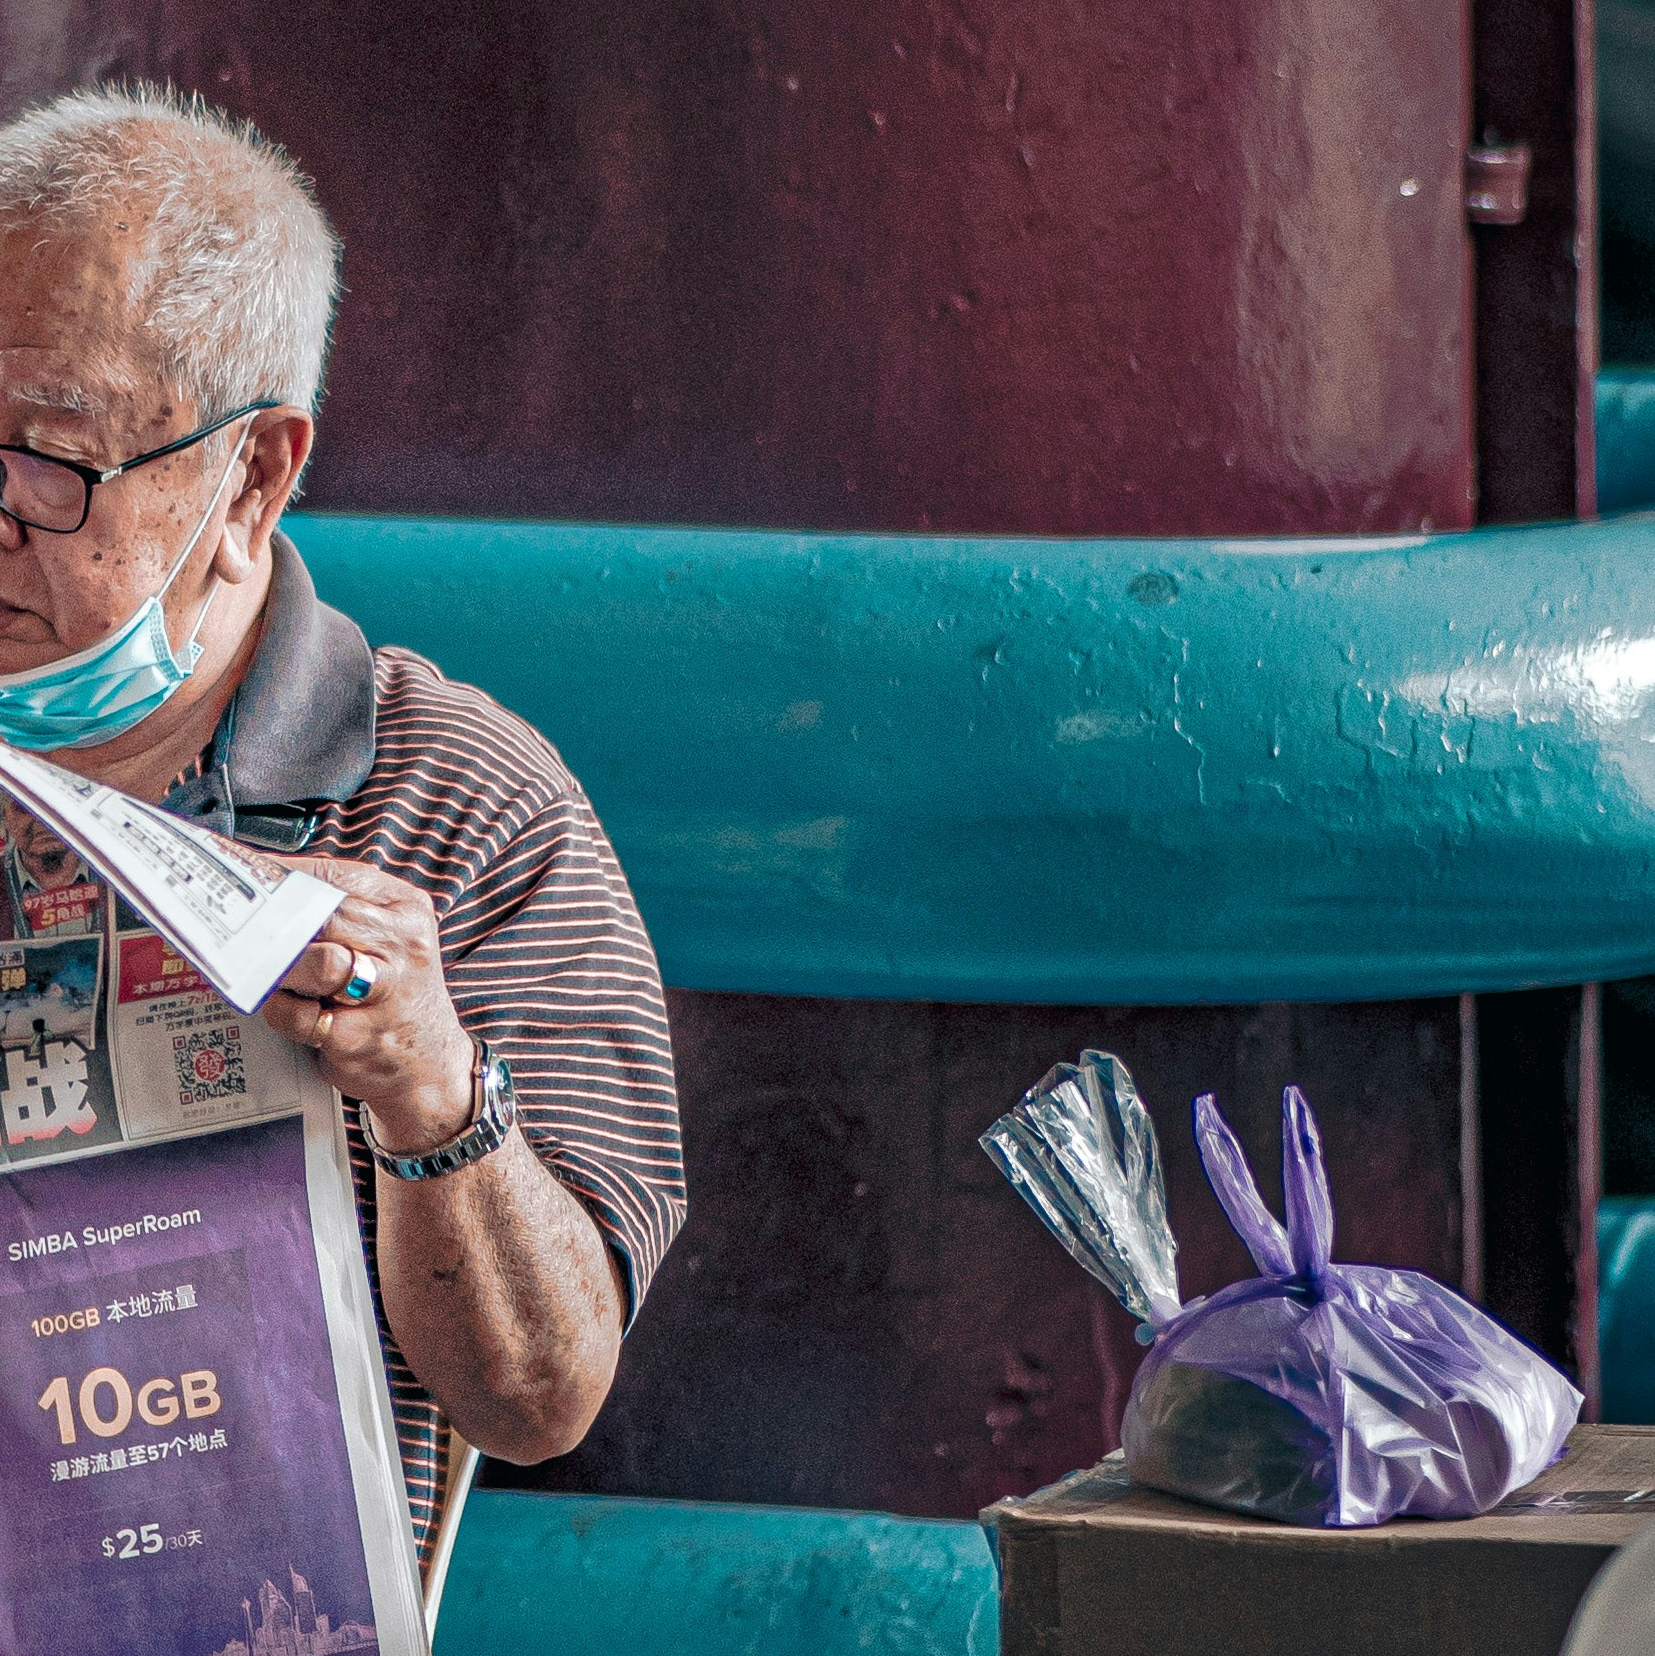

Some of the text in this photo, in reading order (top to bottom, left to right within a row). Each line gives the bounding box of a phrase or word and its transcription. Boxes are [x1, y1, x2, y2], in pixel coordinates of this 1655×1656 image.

[41, 903, 86, 927] 5角战
[132, 975, 203, 995] 本期万字
[8, 1208, 202, 1262] SIMBA SuperRoam
[31, 1284, 199, 1338] 100GB 本地流量
[38, 1367, 221, 1445] 10GB
[49, 1428, 228, 1482] 漫游流量至57个地点
